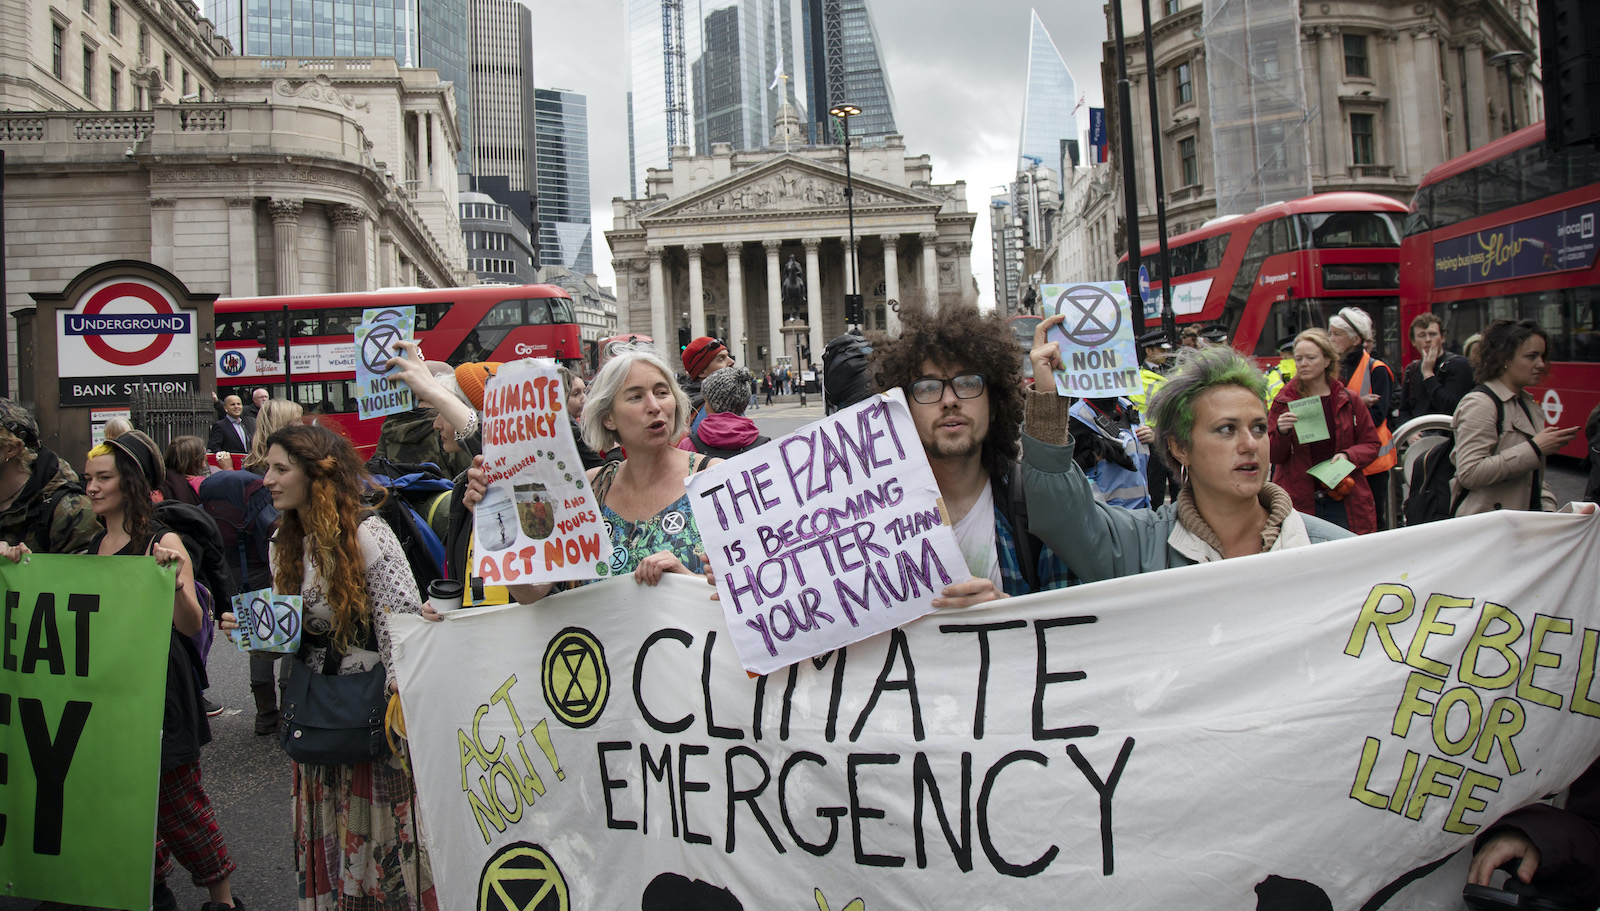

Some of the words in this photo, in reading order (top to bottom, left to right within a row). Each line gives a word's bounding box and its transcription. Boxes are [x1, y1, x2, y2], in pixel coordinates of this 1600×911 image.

[1436, 257, 1458, 272] Helping
[1458, 252, 1485, 265] business
[71, 317, 185, 331] UNDERGROUND
[515, 343, 533, 355] Go
[1072, 350, 1116, 371] NON
[73, 384, 117, 397] BANK
[124, 382, 187, 395] STATION
[361, 390, 409, 412] VIOLENT
[370, 376, 397, 394] NON
[485, 376, 562, 418] CLIMATE
[1056, 370, 1137, 391] VIOLENT
[483, 412, 556, 446] EMERGENCY
[494, 456, 506, 467] MY
[700, 462, 781, 531] THE
[778, 401, 906, 507] PLANET
[557, 510, 596, 535] YOURS
[563, 496, 585, 510] AND
[722, 539, 746, 566] IS
[756, 477, 904, 558] BECOMING
[478, 546, 536, 584] ACT
[544, 533, 600, 572] NOW
[725, 521, 890, 614] HOTTER
[884, 506, 942, 545] THAN
[746, 587, 835, 657] YOUR
[833, 538, 952, 627] MUM
[235, 598, 252, 648] VIOLENT
[244, 608, 254, 635] NON
[1343, 583, 1600, 719] REBEL
[633, 615, 1099, 742] CLIMATE
[457, 673, 526, 791] ACT
[1391, 671, 1526, 776] FOR
[467, 718, 566, 845] NOW!
[1350, 736, 1503, 835] LIFE
[597, 736, 1136, 878] EMERGENCY
